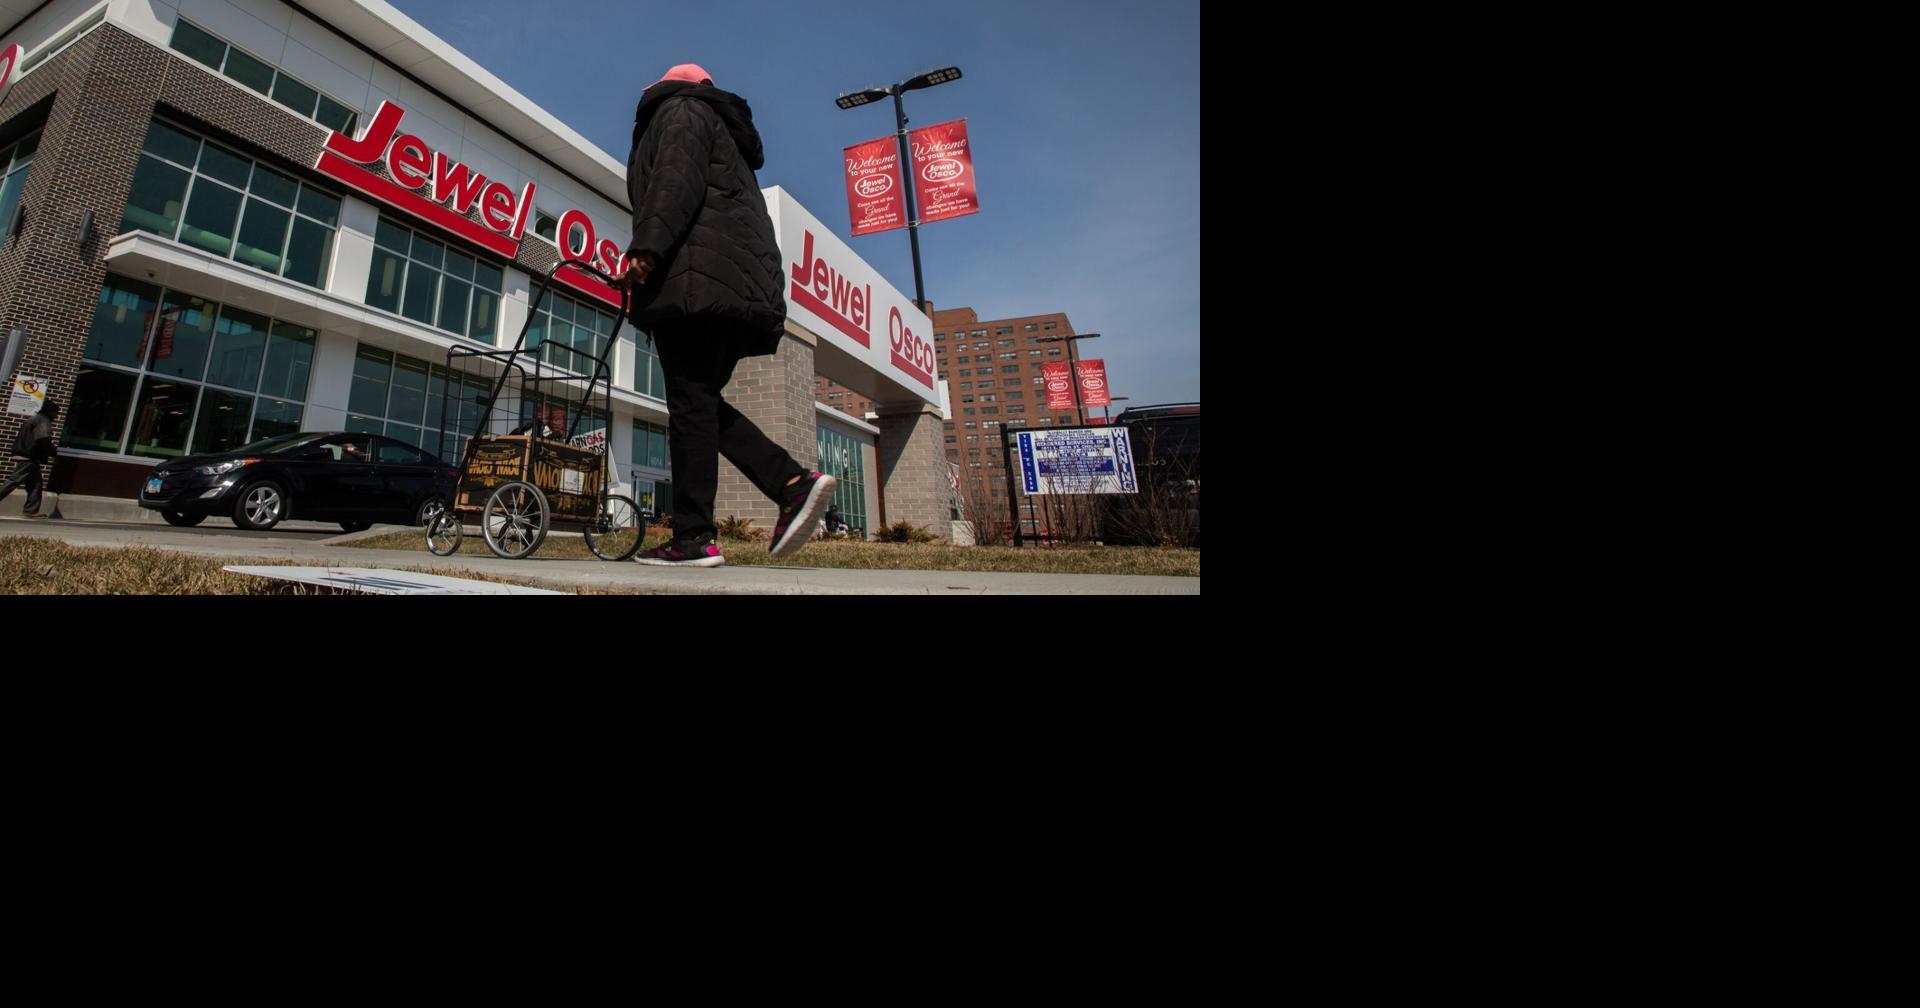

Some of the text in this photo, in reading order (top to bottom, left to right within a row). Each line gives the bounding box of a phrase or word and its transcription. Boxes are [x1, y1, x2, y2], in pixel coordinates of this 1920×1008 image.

[912, 139, 966, 158] Welcome
[927, 153, 944, 161] your
[947, 149, 964, 157] new
[323, 100, 537, 240] Jewel
[846, 153, 896, 173] Welcome
[860, 168, 877, 176] your
[879, 163, 893, 171] new
[927, 162, 955, 173] Jewel
[860, 177, 885, 188] Jewel
[932, 188, 960, 205] Grand
[792, 229, 870, 332] Jewel
[889, 305, 934, 374] Osco
[587, 431, 604, 446] GAS
[1111, 428, 1133, 490] WARNING
